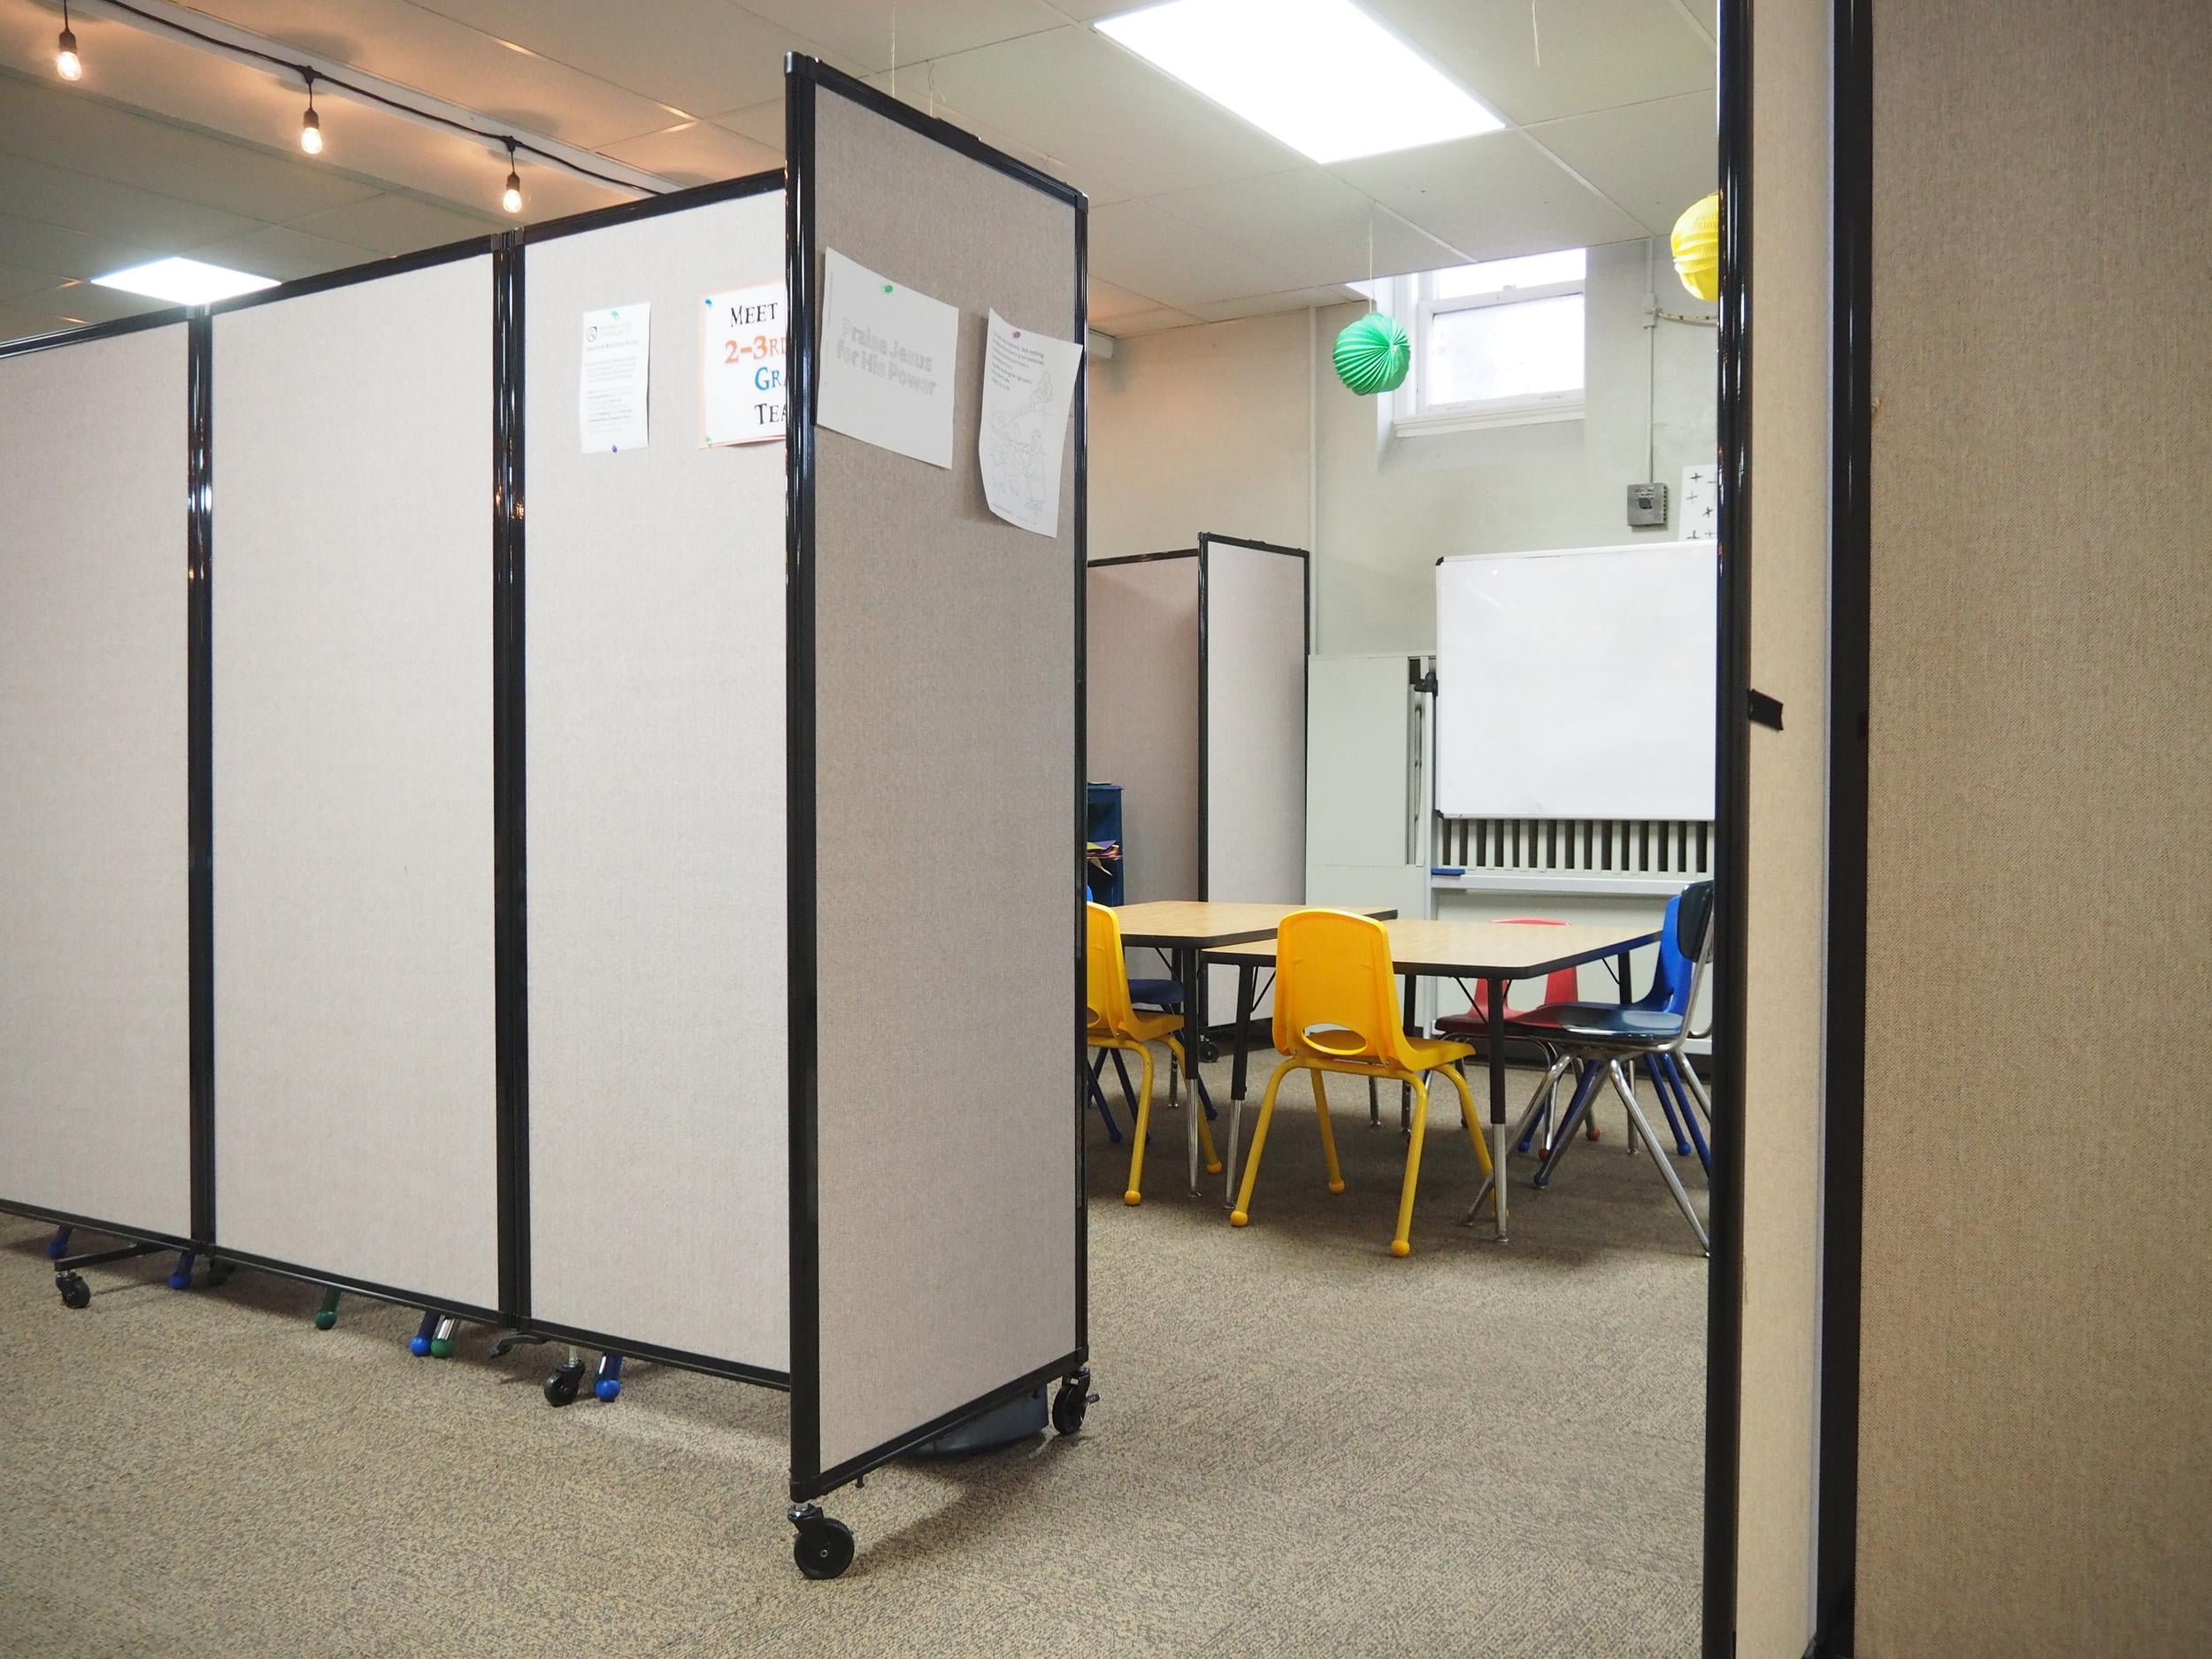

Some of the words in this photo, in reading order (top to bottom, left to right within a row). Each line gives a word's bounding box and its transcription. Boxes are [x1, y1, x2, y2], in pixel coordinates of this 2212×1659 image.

[730, 303, 779, 328] MEET
[841, 317, 887, 355] Praise
[889, 339, 933, 373] Jesus
[755, 366, 786, 391] GR
[836, 337, 859, 366] for
[861, 349, 886, 378] His
[887, 361, 938, 396] Power
